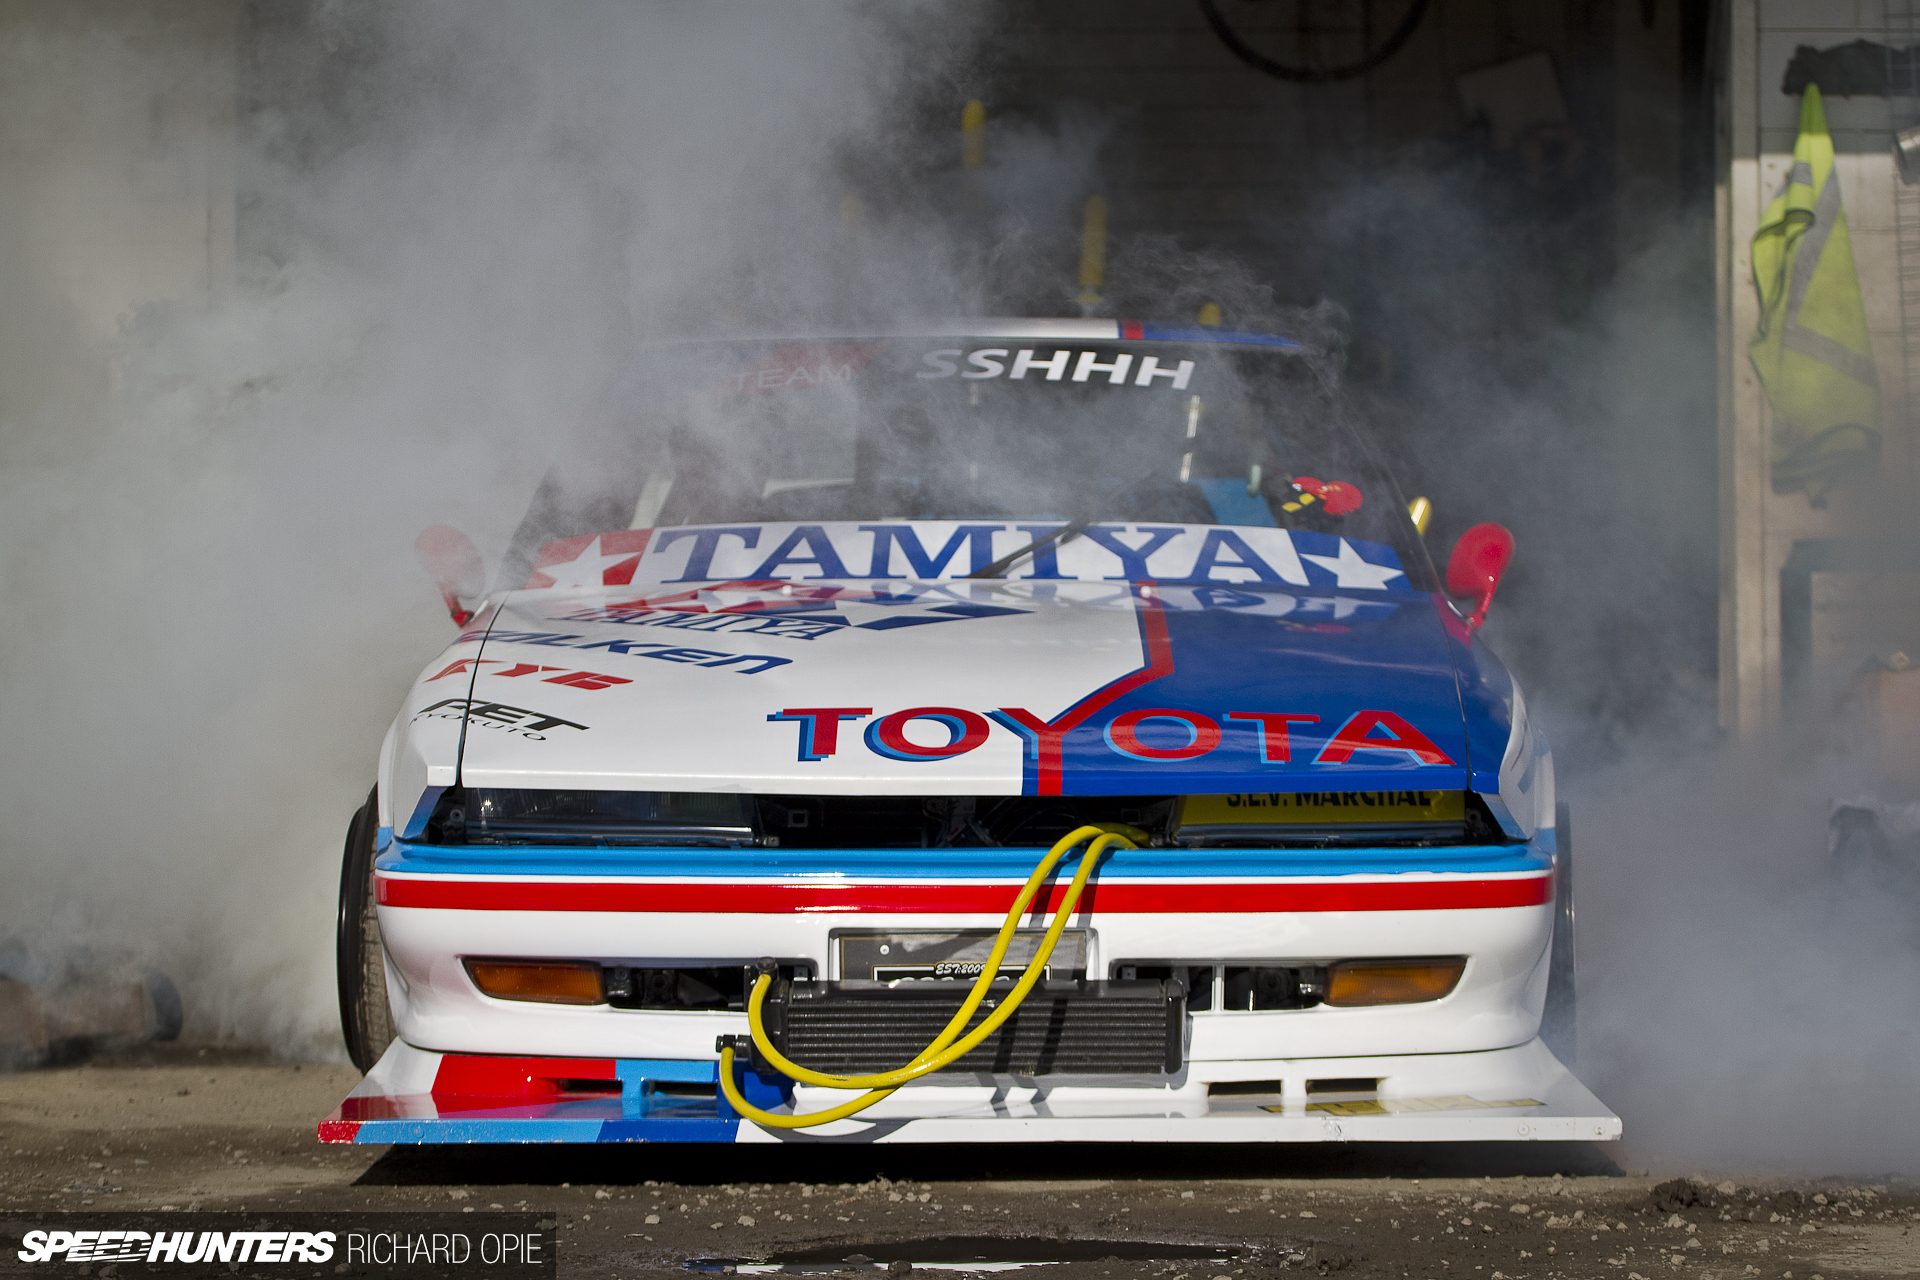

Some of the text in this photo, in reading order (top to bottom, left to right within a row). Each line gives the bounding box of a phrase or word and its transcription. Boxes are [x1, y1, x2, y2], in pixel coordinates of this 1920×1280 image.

[733, 348, 1196, 392] TEAM SSHHH
[653, 523, 1312, 587] TAMIYA
[767, 706, 1458, 795] TOYOTA
